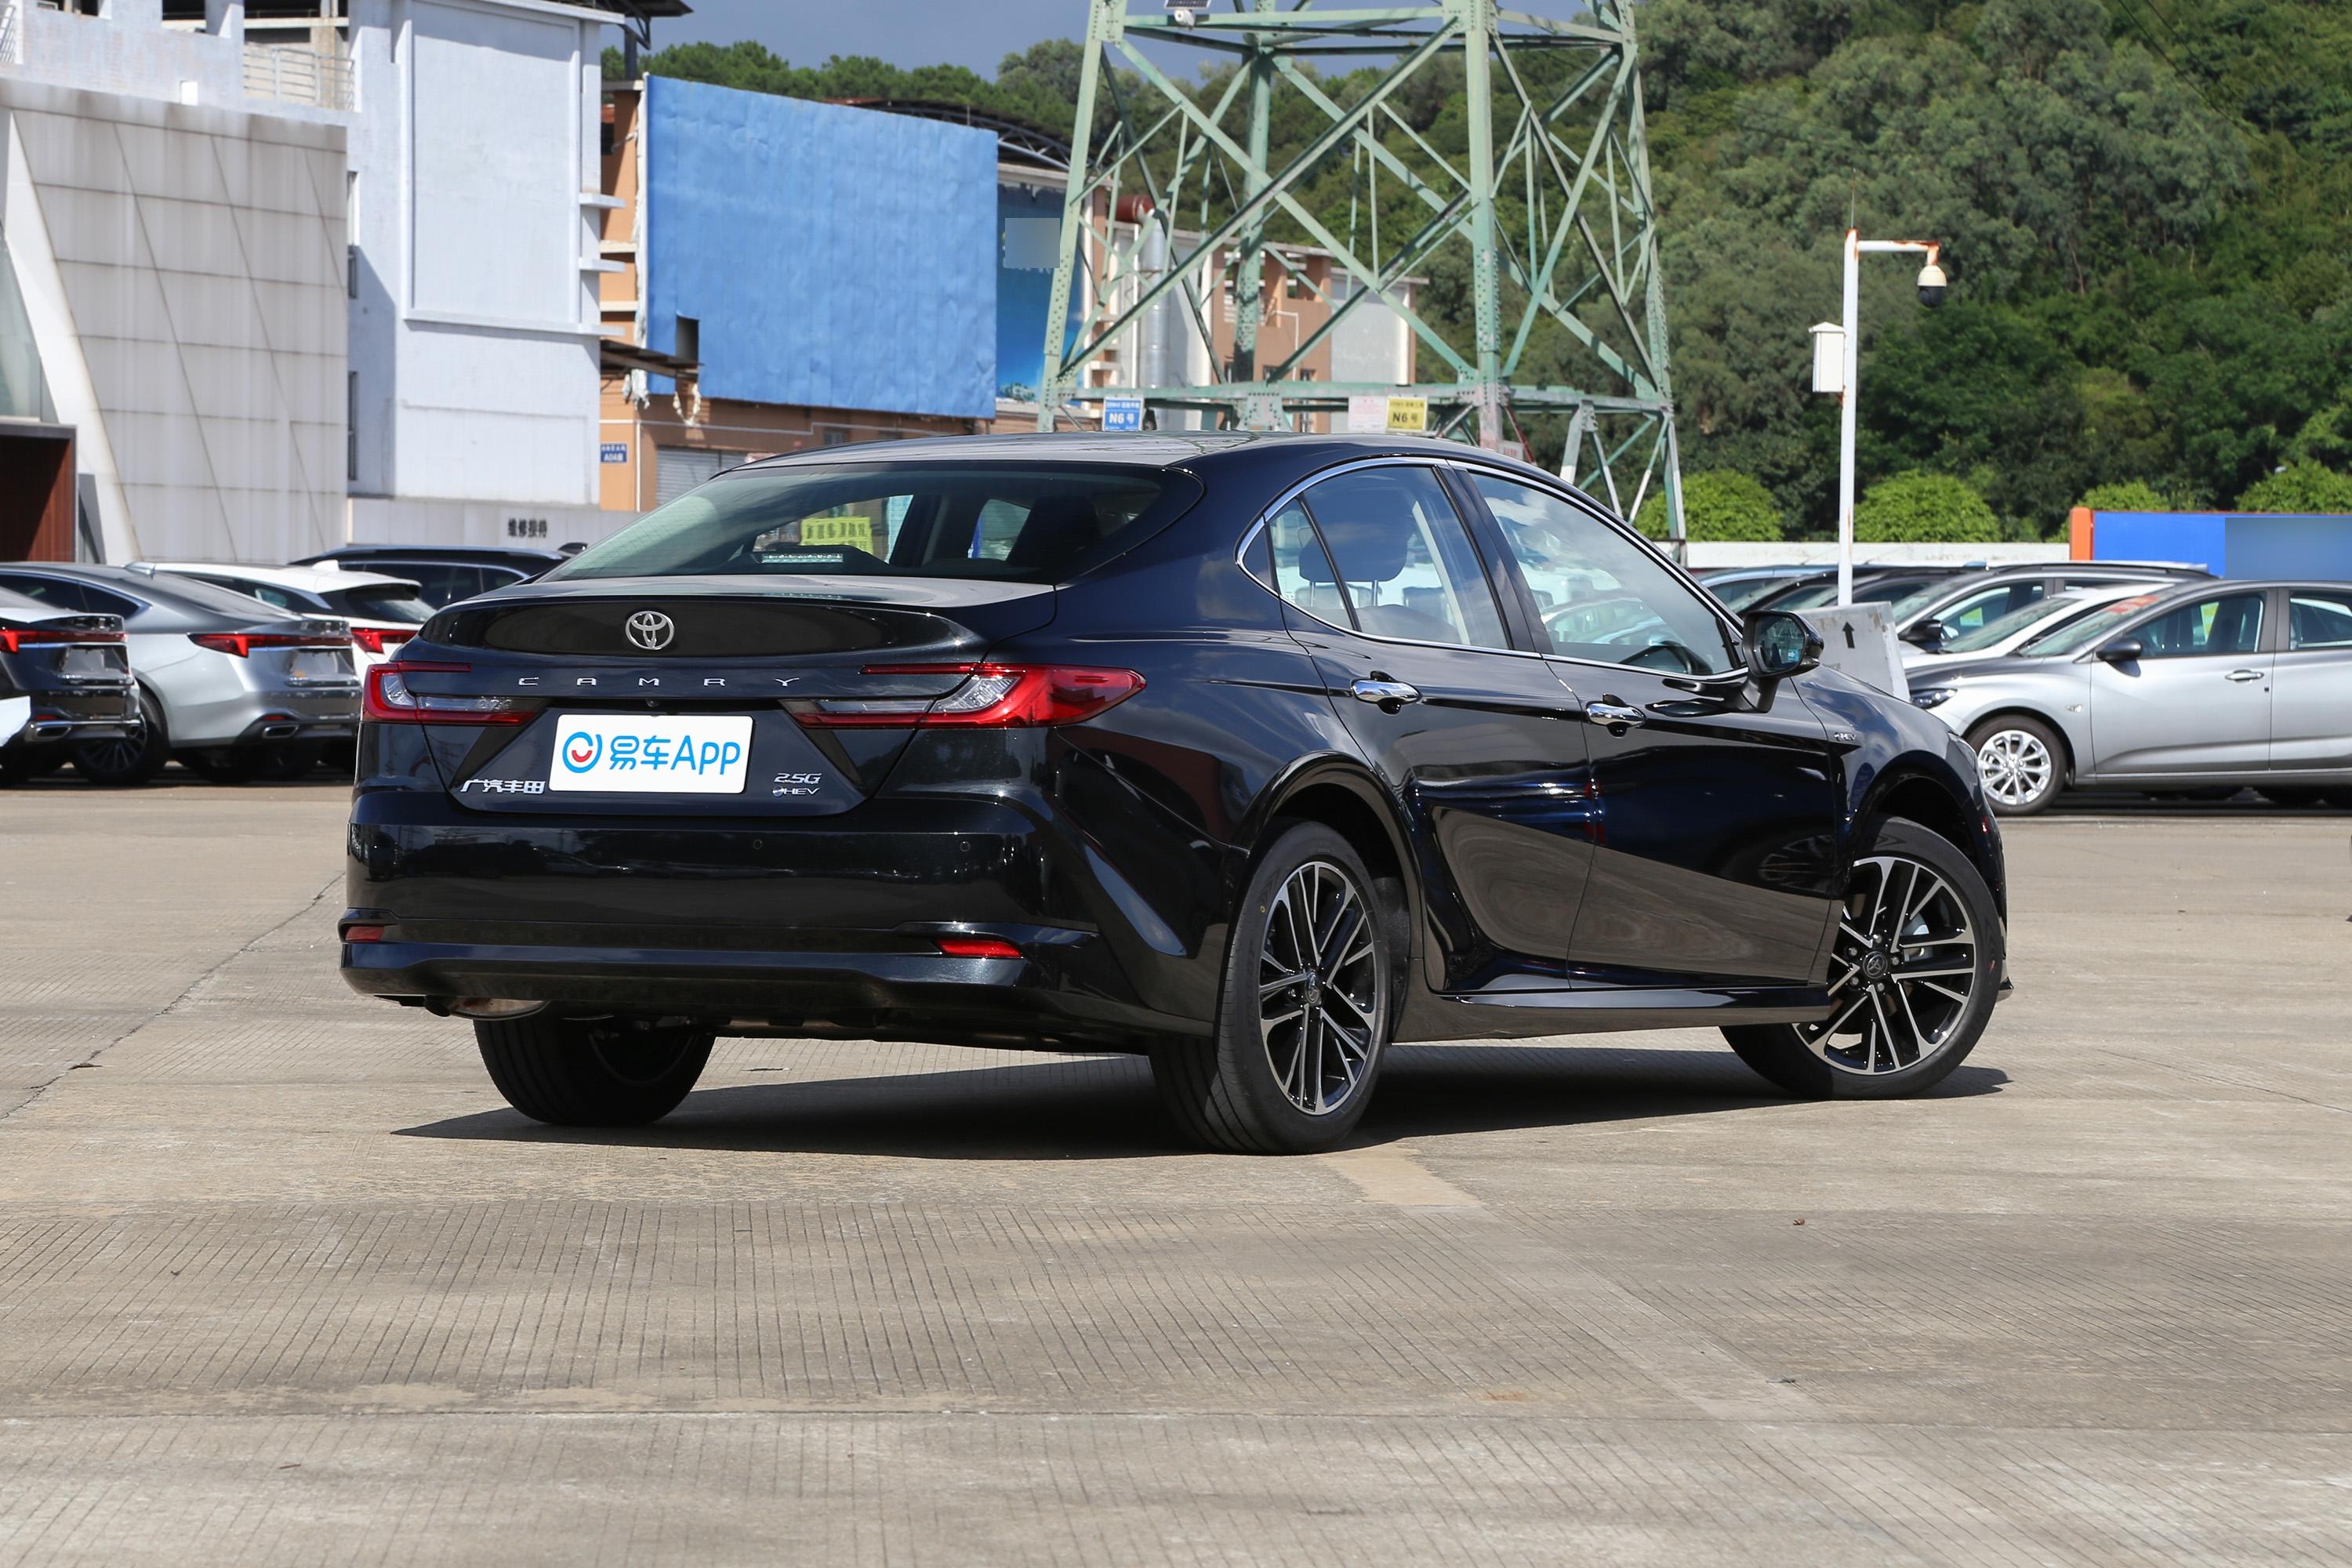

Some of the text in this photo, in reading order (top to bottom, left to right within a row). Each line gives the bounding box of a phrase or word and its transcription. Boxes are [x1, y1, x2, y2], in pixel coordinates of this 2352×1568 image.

[518, 677, 800, 687] CAMRY
[609, 735, 741, 775] 易车App
[460, 779, 546, 794] 广汽丰田
